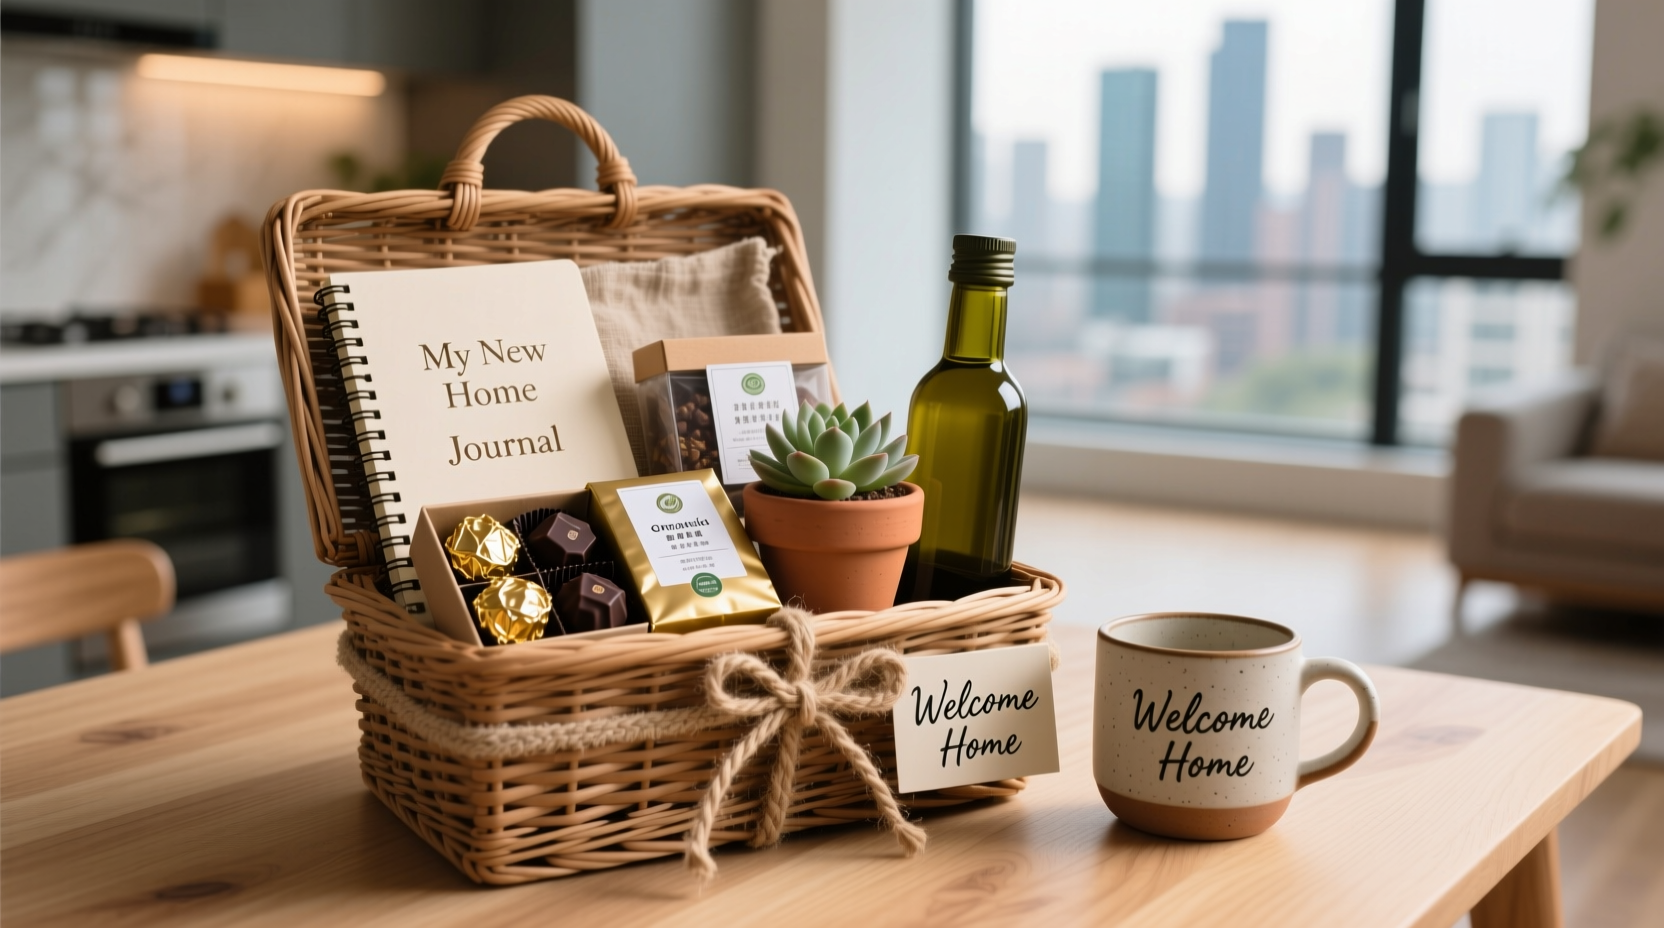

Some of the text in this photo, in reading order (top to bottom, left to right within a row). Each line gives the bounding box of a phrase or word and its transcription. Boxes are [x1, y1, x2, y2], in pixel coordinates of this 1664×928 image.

[418, 338, 547, 377] My New
[442, 380, 538, 409] Home
[448, 424, 565, 466] Journal
[911, 679, 1039, 726] Welcome
[1133, 688, 1275, 734] Welcome
[940, 725, 1022, 768] Home
[1158, 740, 1255, 783] Home
